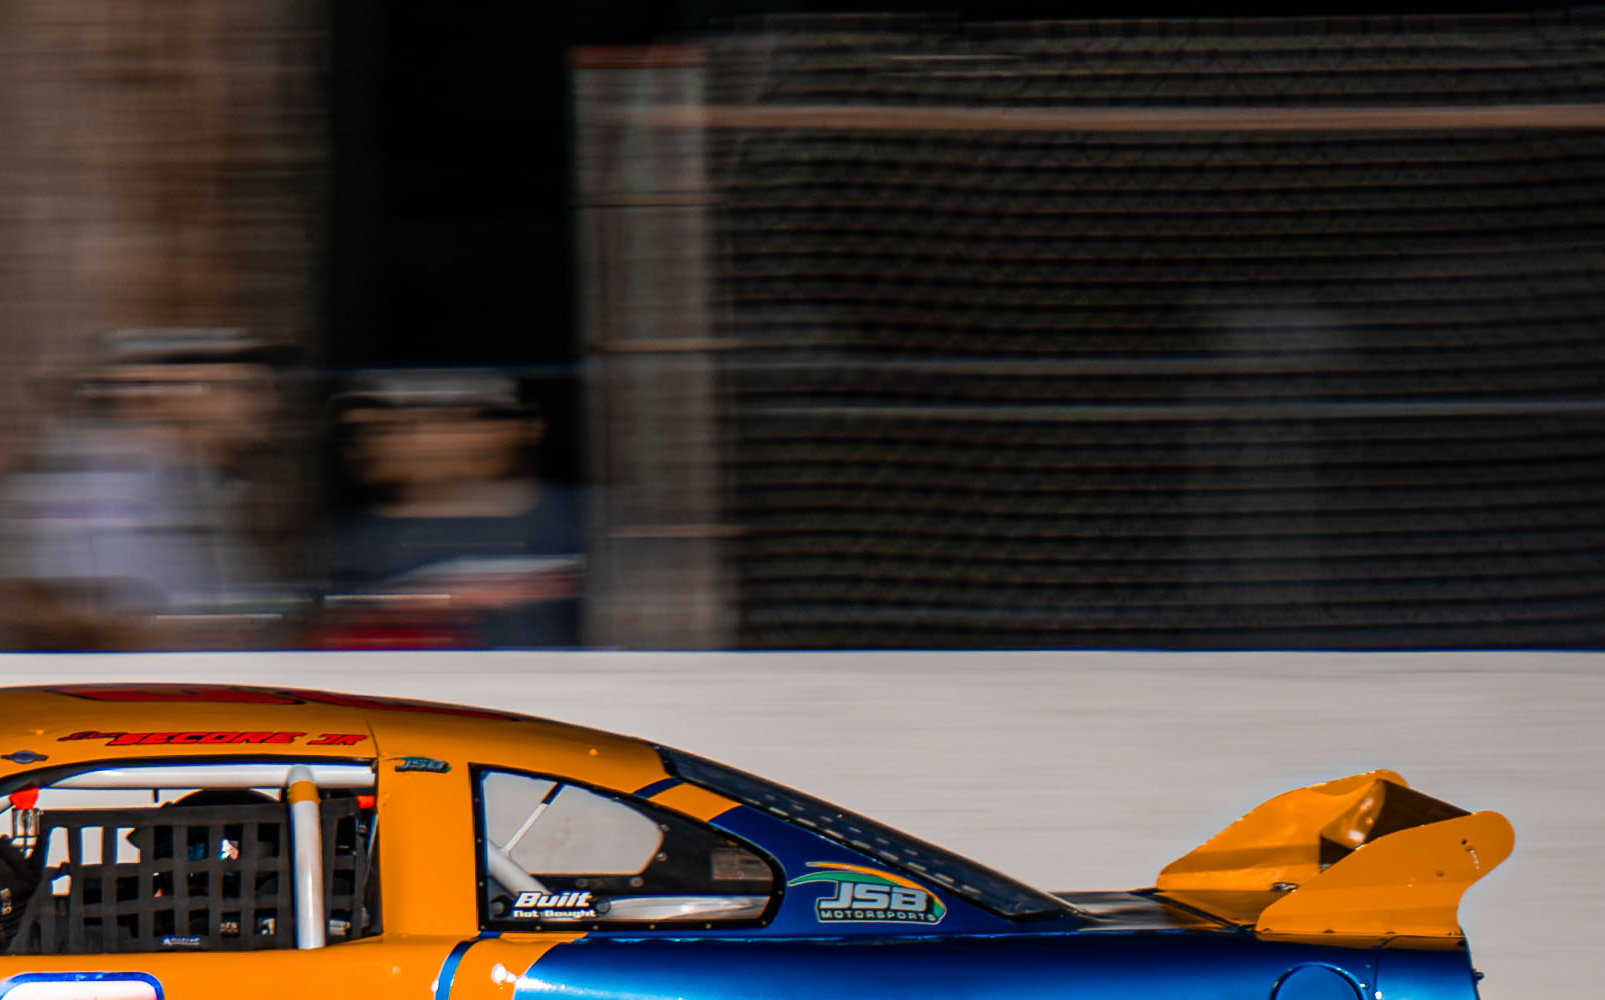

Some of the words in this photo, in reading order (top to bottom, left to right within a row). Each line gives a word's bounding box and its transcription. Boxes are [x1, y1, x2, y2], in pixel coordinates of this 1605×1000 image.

[514, 892, 593, 908] Built
[819, 882, 928, 912] JSB
[820, 910, 937, 922] MOTORSPORTS
